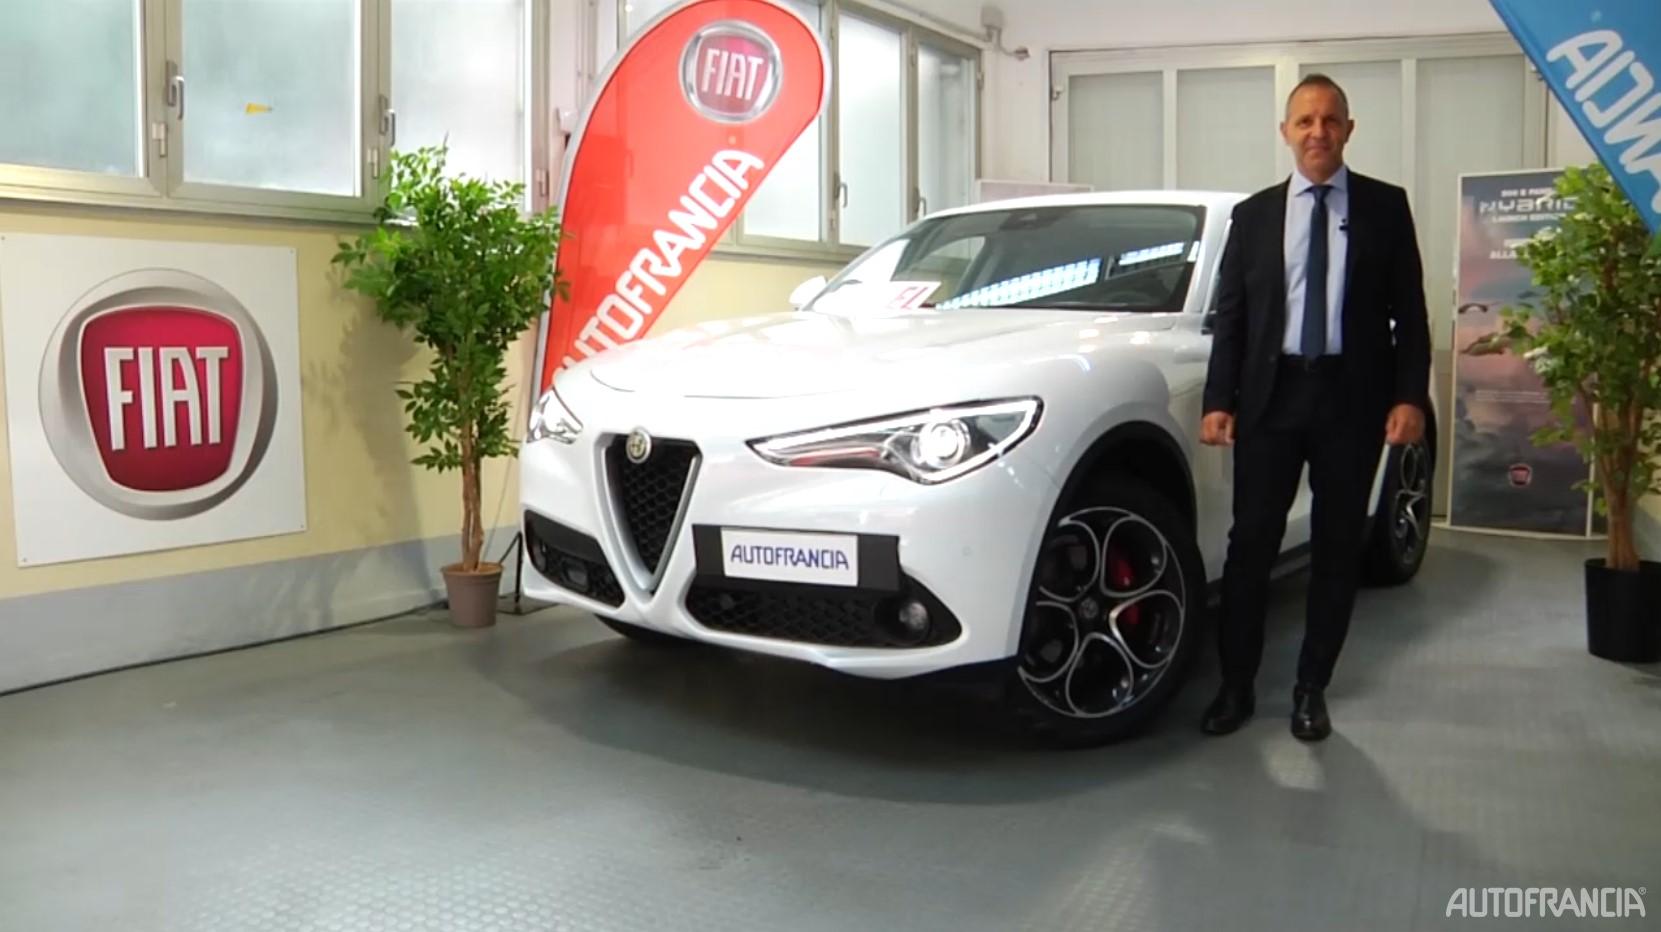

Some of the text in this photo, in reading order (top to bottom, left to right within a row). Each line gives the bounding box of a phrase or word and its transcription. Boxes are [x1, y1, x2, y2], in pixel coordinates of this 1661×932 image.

[702, 48, 764, 100] FIAT
[553, 149, 765, 372] TOFRANCIA
[103, 346, 229, 451] FIAT
[730, 544, 849, 570] AUTOFRANCIA
